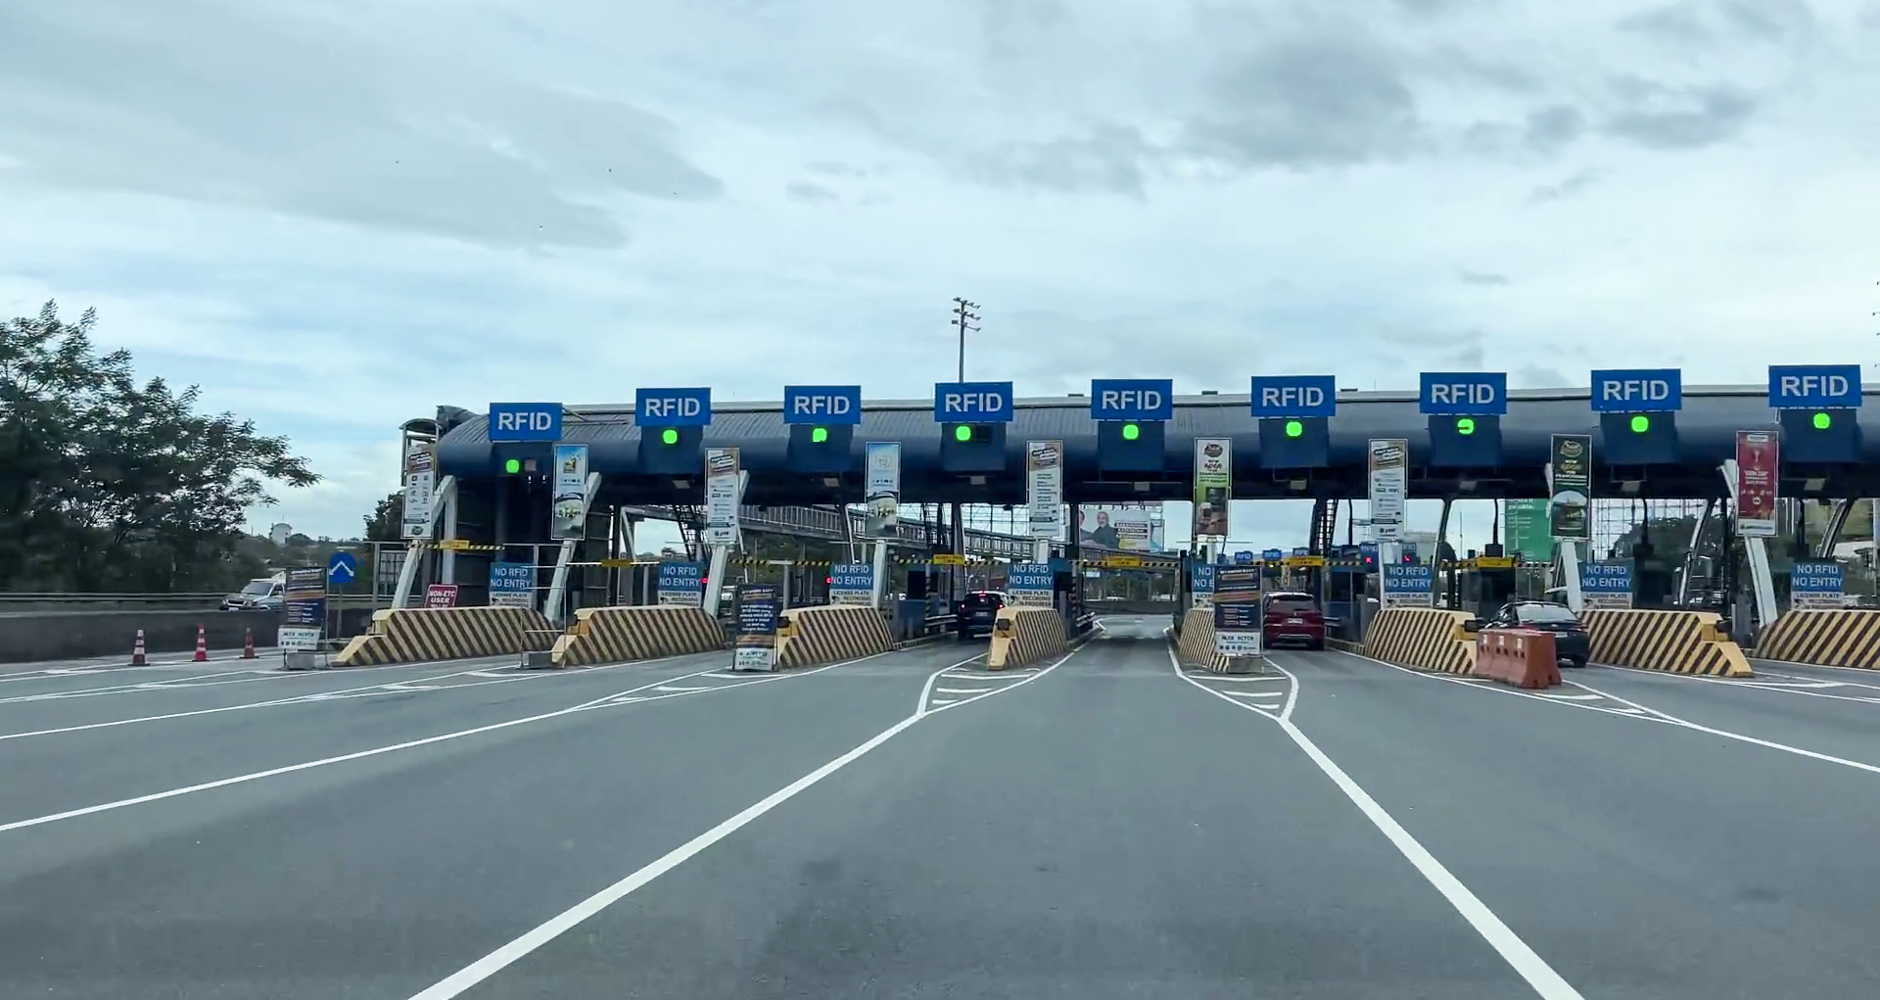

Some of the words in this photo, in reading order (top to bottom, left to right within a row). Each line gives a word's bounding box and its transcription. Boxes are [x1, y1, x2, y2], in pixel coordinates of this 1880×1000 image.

[1603, 379, 1668, 400] RFID
[1781, 375, 1848, 396] RFID
[1262, 387, 1324, 406] RFID
[1432, 384, 1494, 403] RFID
[945, 393, 1002, 412] RFID
[1102, 391, 1161, 409] RFID
[645, 398, 700, 417] RFID
[794, 396, 850, 415] RFID
[498, 412, 552, 430] RFID
[495, 568, 507, 576] NO
[508, 568, 528, 577] RFID
[664, 566, 676, 575] NO
[678, 567, 697, 576] RFID
[834, 565, 847, 573] NO
[850, 565, 869, 574] RFID
[1013, 565, 1026, 573] NO
[1028, 565, 1048, 574] RFID
[1389, 567, 1403, 575] NO
[1406, 567, 1428, 575] RFID
[1586, 566, 1600, 574] NO
[1604, 566, 1627, 574] RFID
[1797, 565, 1812, 573] NO
[1814, 566, 1838, 574] RFID
[490, 579, 502, 587] NO
[504, 580, 531, 588] ENTRY
[660, 578, 672, 586] NO
[673, 578, 700, 586] ENTRY
[831, 576, 842, 584] NO
[844, 576, 872, 585] ENTRY
[1010, 576, 1022, 584] NO
[1024, 576, 1052, 585] ENTRY
[1194, 579, 1206, 587] NO
[1386, 579, 1398, 587] NO
[1401, 579, 1432, 588] ENTRY
[1582, 578, 1596, 586] NO
[1599, 578, 1631, 587] ENTRY
[1792, 578, 1807, 586] NO
[1810, 578, 1842, 587] ENTRY
